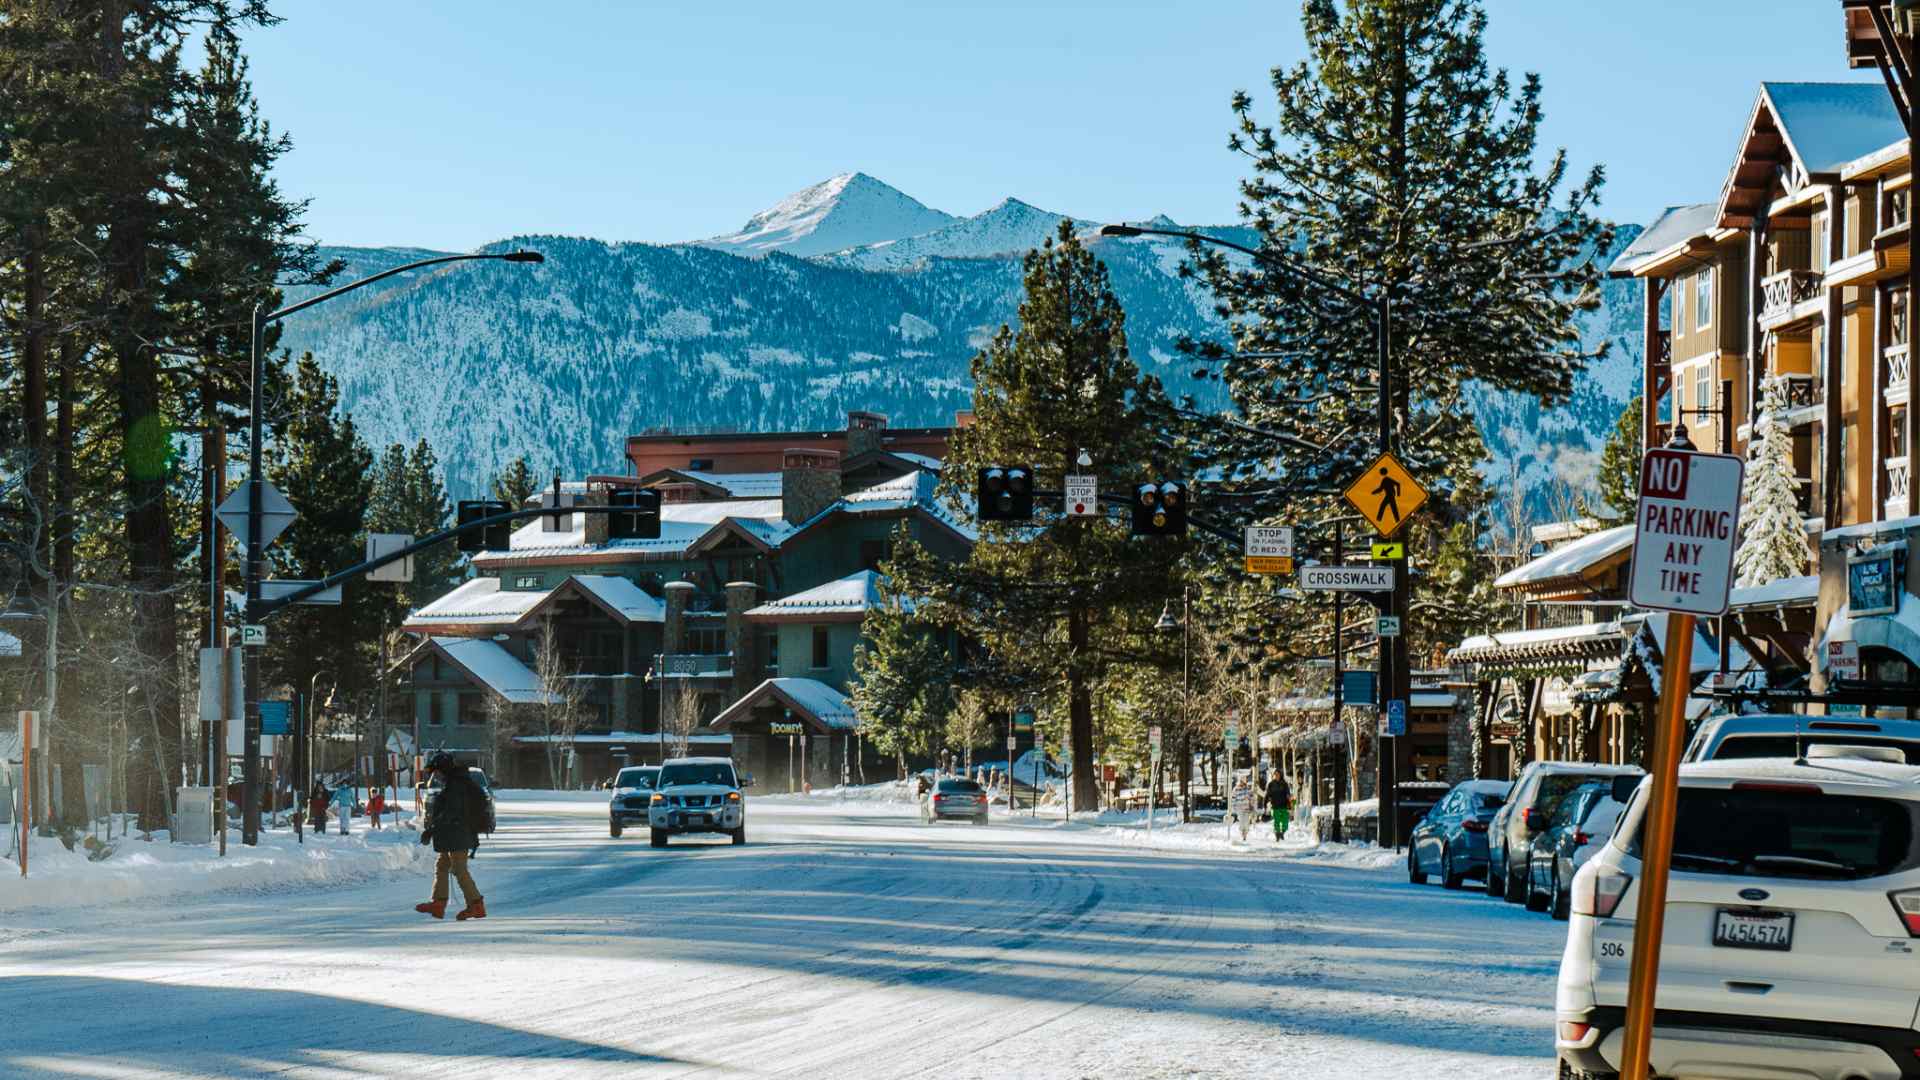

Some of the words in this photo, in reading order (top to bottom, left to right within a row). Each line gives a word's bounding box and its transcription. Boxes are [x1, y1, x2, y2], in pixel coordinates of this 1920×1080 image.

[1648, 457, 1683, 492] NO
[1071, 488, 1091, 496] STOP
[1645, 504, 1730, 540] PARKING
[1257, 529, 1282, 537] STOP
[1664, 541, 1703, 565] ANY
[1308, 572, 1386, 585] CROSSWALK
[1661, 569, 1701, 594] TIME
[1830, 658, 1857, 666] PARKING
[1721, 923, 1786, 943] 1454574
[1601, 942, 1625, 957] 506
